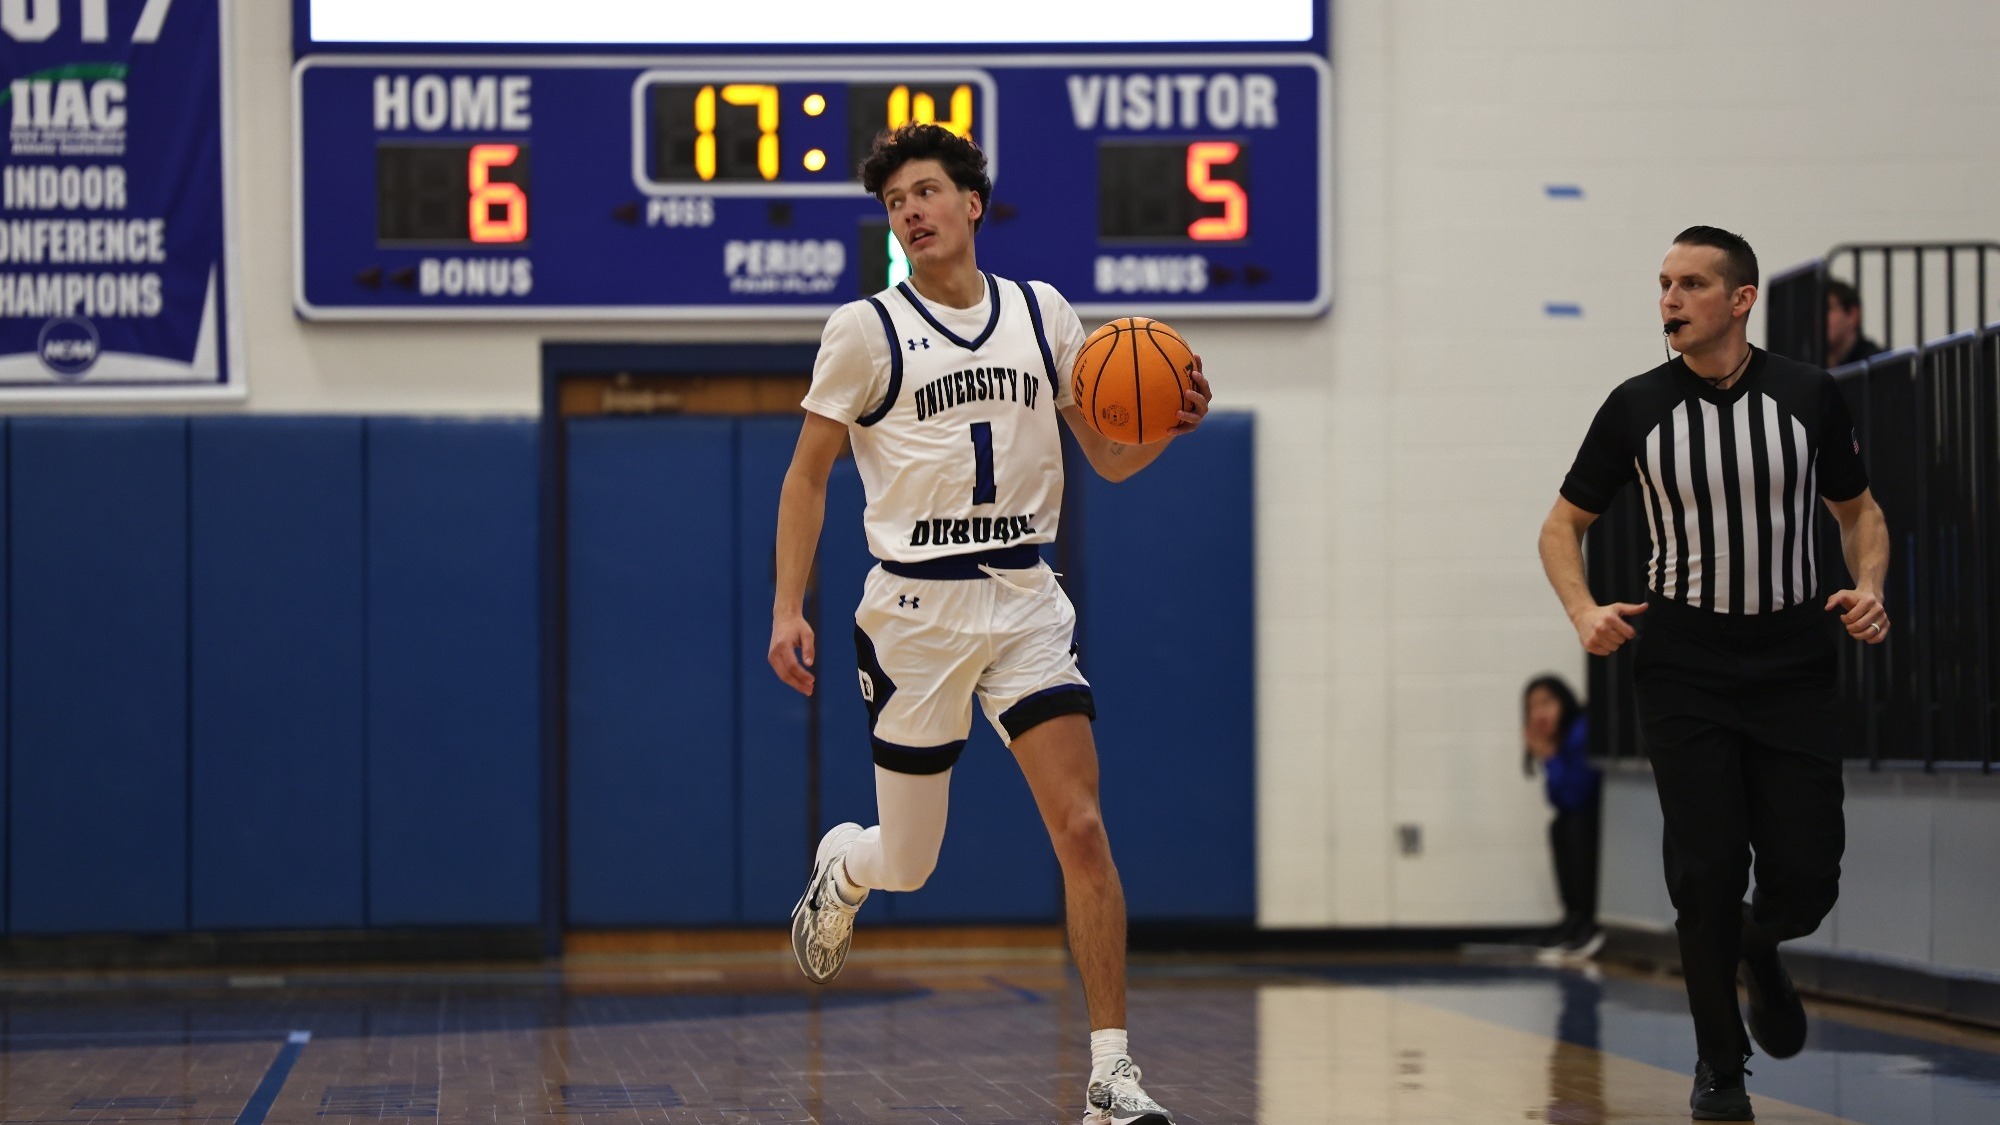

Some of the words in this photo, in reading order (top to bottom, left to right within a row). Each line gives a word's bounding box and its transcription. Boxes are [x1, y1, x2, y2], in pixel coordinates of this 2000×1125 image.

[11, 79, 127, 127] IIAC
[374, 75, 532, 130] HOME
[1067, 74, 1278, 129] VISITOR
[3, 166, 127, 210] INDOOR
[468, 144, 528, 243] 6
[1187, 141, 1248, 241] 5
[0, 218, 166, 264] ONFERENCE
[724, 239, 846, 277] PERIOD
[0, 272, 163, 318] HAMPIONS
[420, 258, 533, 296] BONUS
[1095, 256, 1207, 293] BONUS
[914, 366, 1017, 421] UNIVERSITY
[1023, 371, 1039, 410] OF
[969, 421, 997, 506] 1
